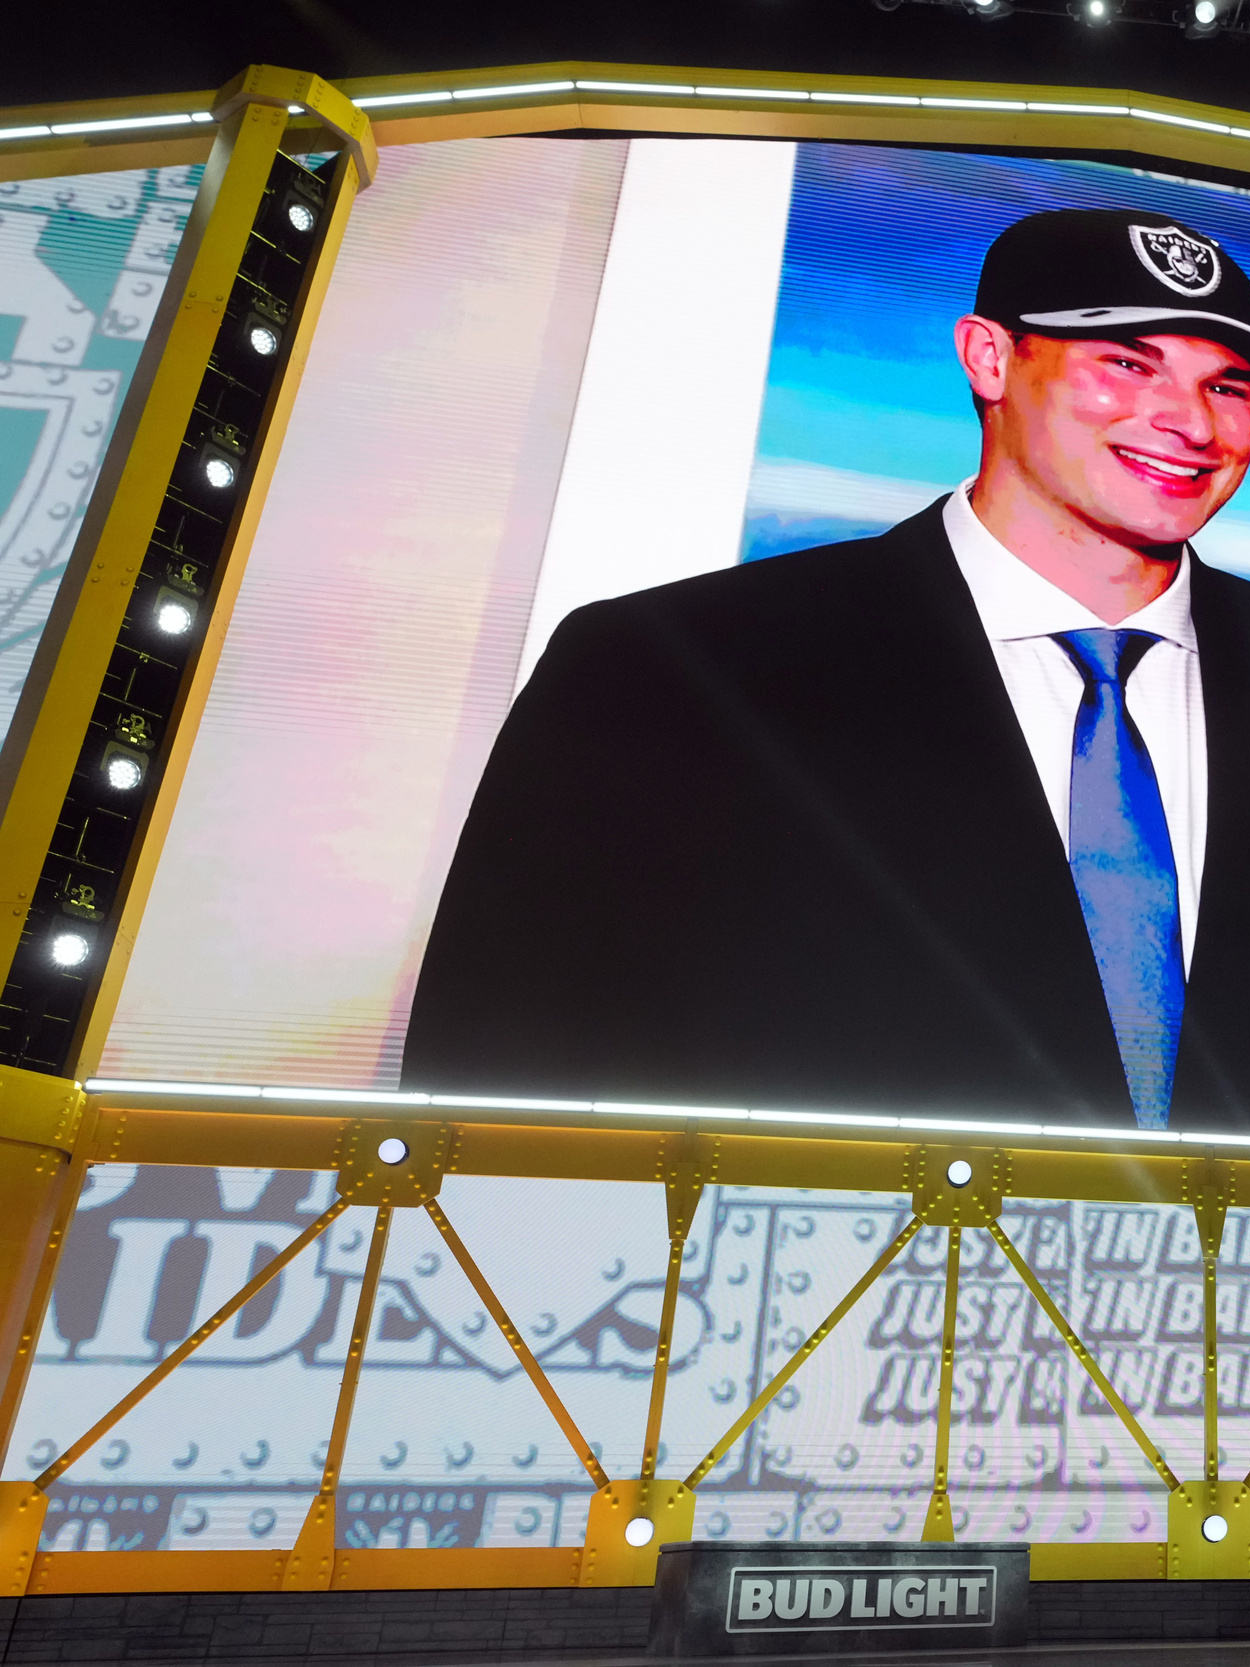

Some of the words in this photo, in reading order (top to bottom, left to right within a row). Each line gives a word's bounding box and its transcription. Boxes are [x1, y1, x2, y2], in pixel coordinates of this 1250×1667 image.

[871, 1281, 1024, 1345] JUST
[864, 1355, 1021, 1418] JUST
[738, 1579, 845, 1620] BUD
[850, 1577, 987, 1618] LIGHT
